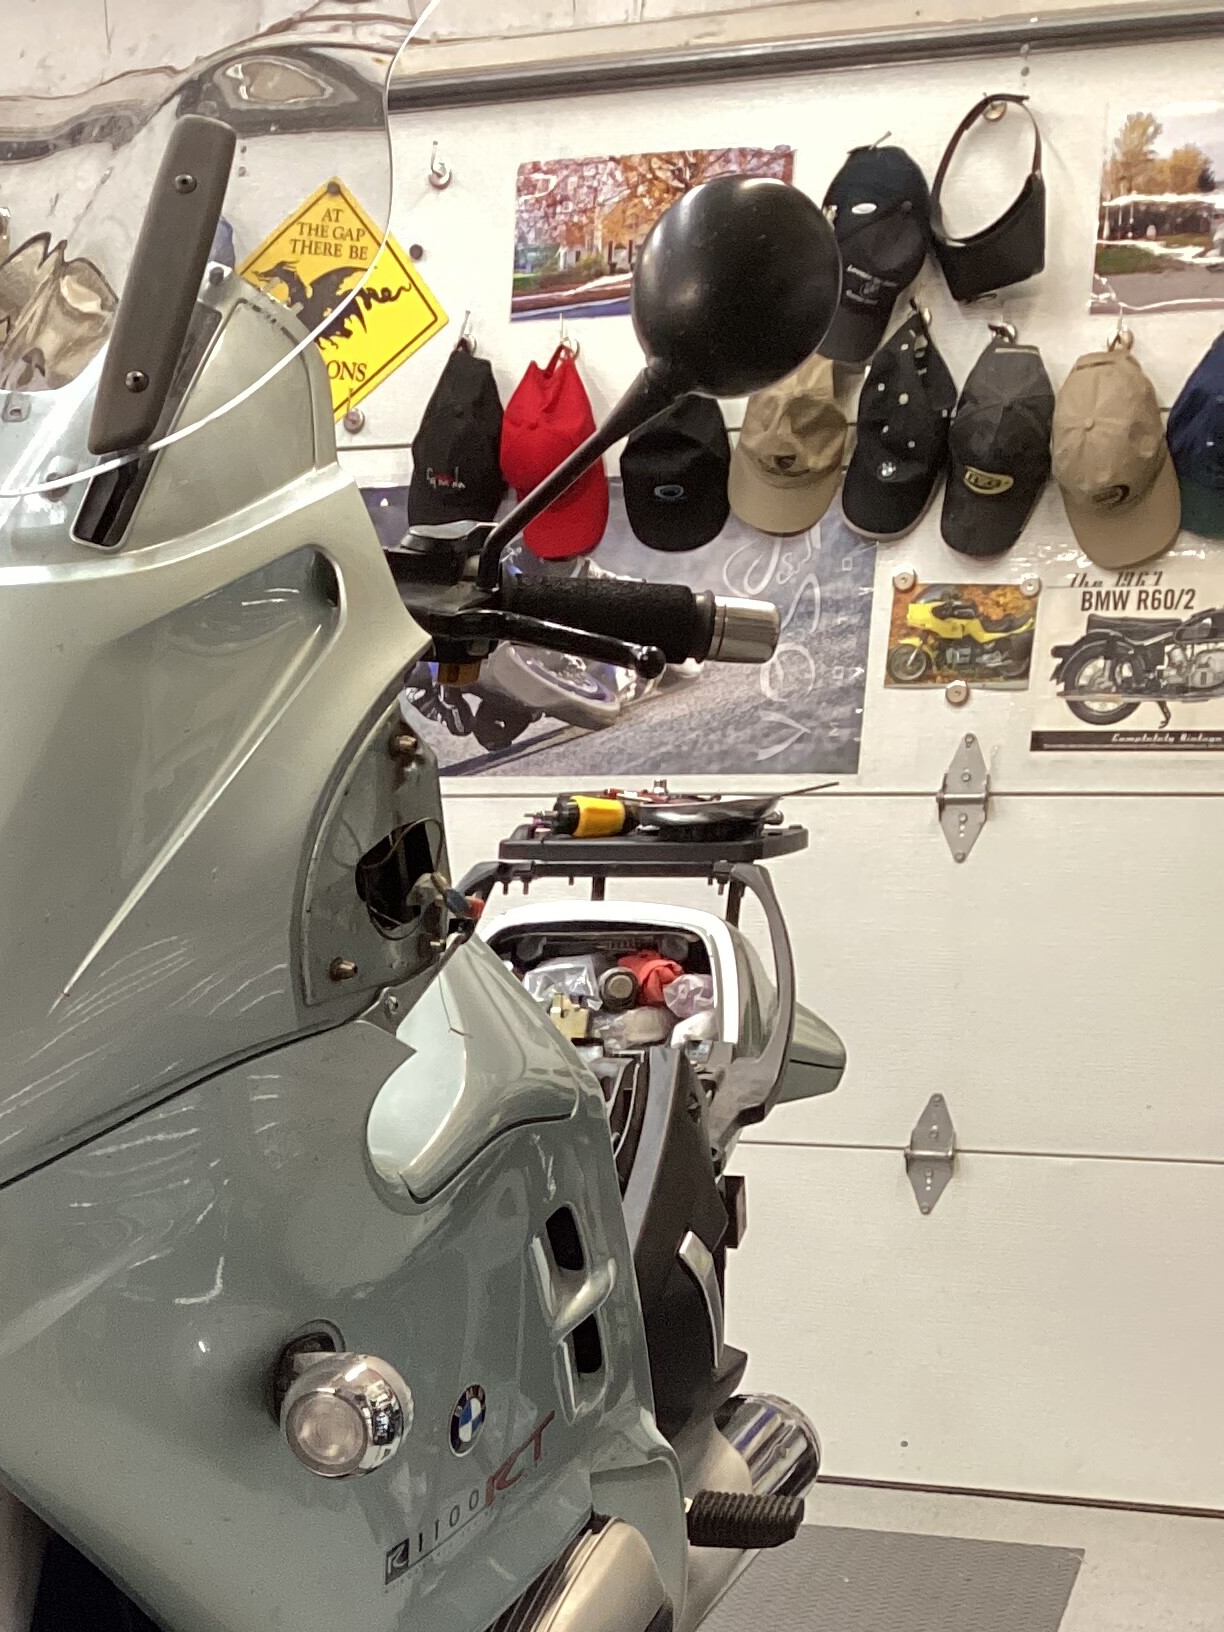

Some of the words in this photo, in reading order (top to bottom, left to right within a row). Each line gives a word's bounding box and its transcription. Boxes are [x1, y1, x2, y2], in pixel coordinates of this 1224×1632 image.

[320, 208, 344, 223] AT
[296, 222, 329, 238] THE
[332, 226, 367, 242] GAP
[289, 239, 343, 258] THERE
[349, 245, 369, 261] BE
[1080, 590, 1131, 612] BMW
[1136, 588, 1197, 612] R60/2
